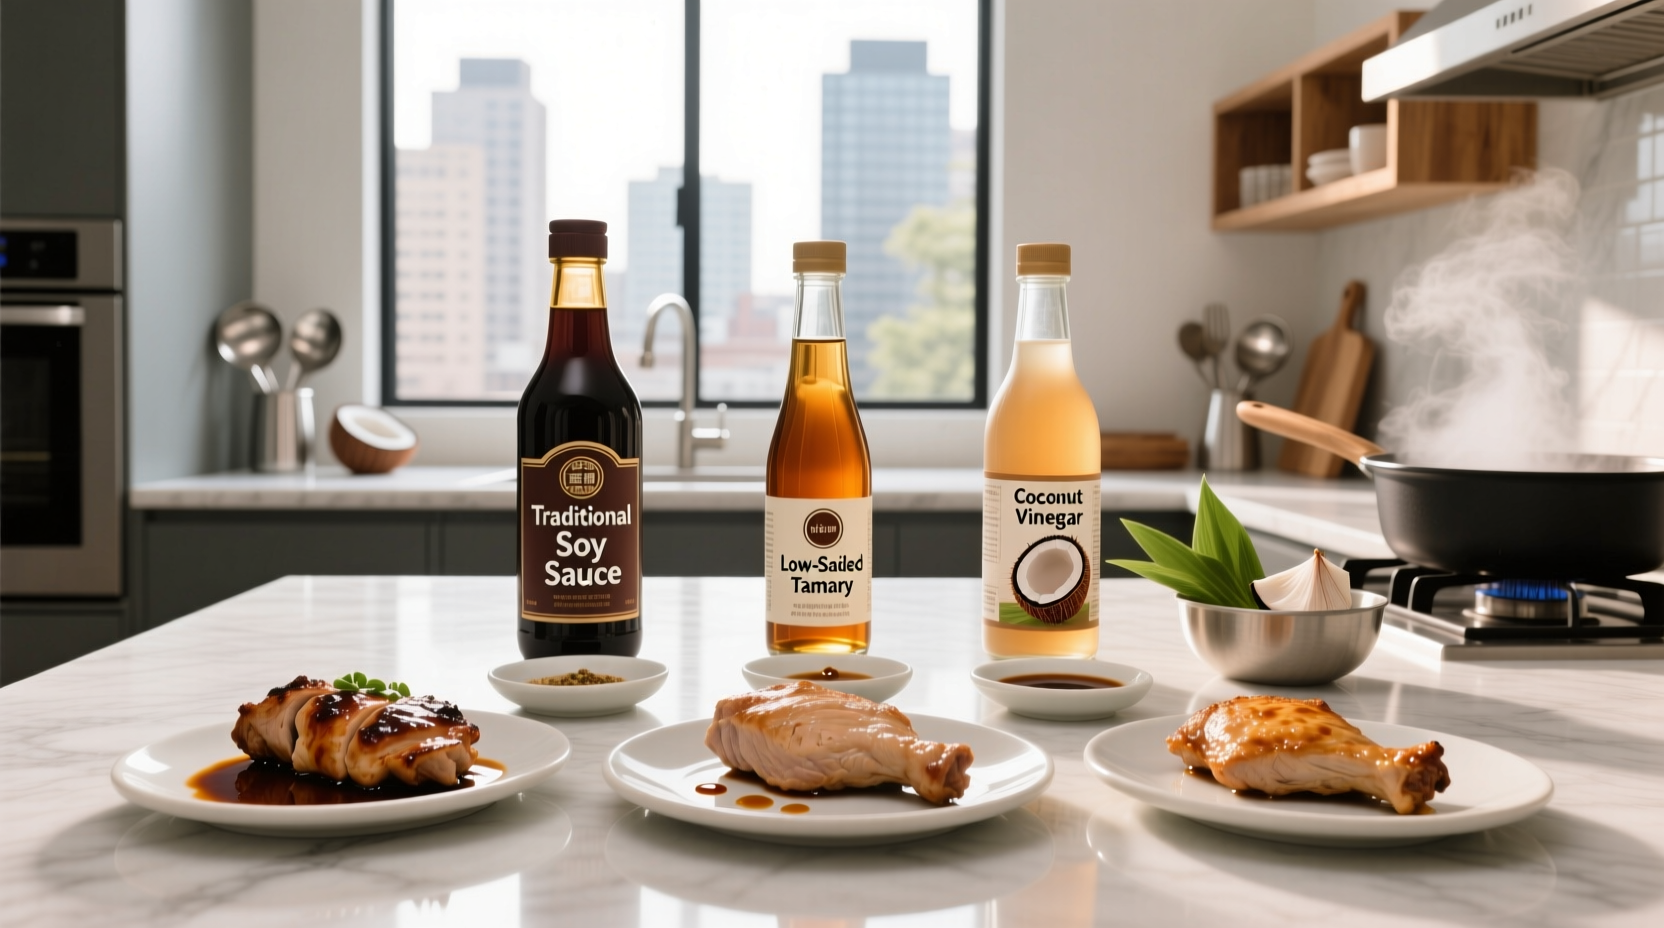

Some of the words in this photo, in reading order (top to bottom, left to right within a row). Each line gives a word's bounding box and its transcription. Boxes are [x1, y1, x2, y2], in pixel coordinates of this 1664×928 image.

[1014, 488, 1083, 504] Coconut
[531, 504, 632, 526] Traditional
[1015, 508, 1083, 530] Vinegar
[556, 531, 607, 563] Soy
[544, 560, 622, 586] Sauce
[791, 577, 853, 597] Tamary
